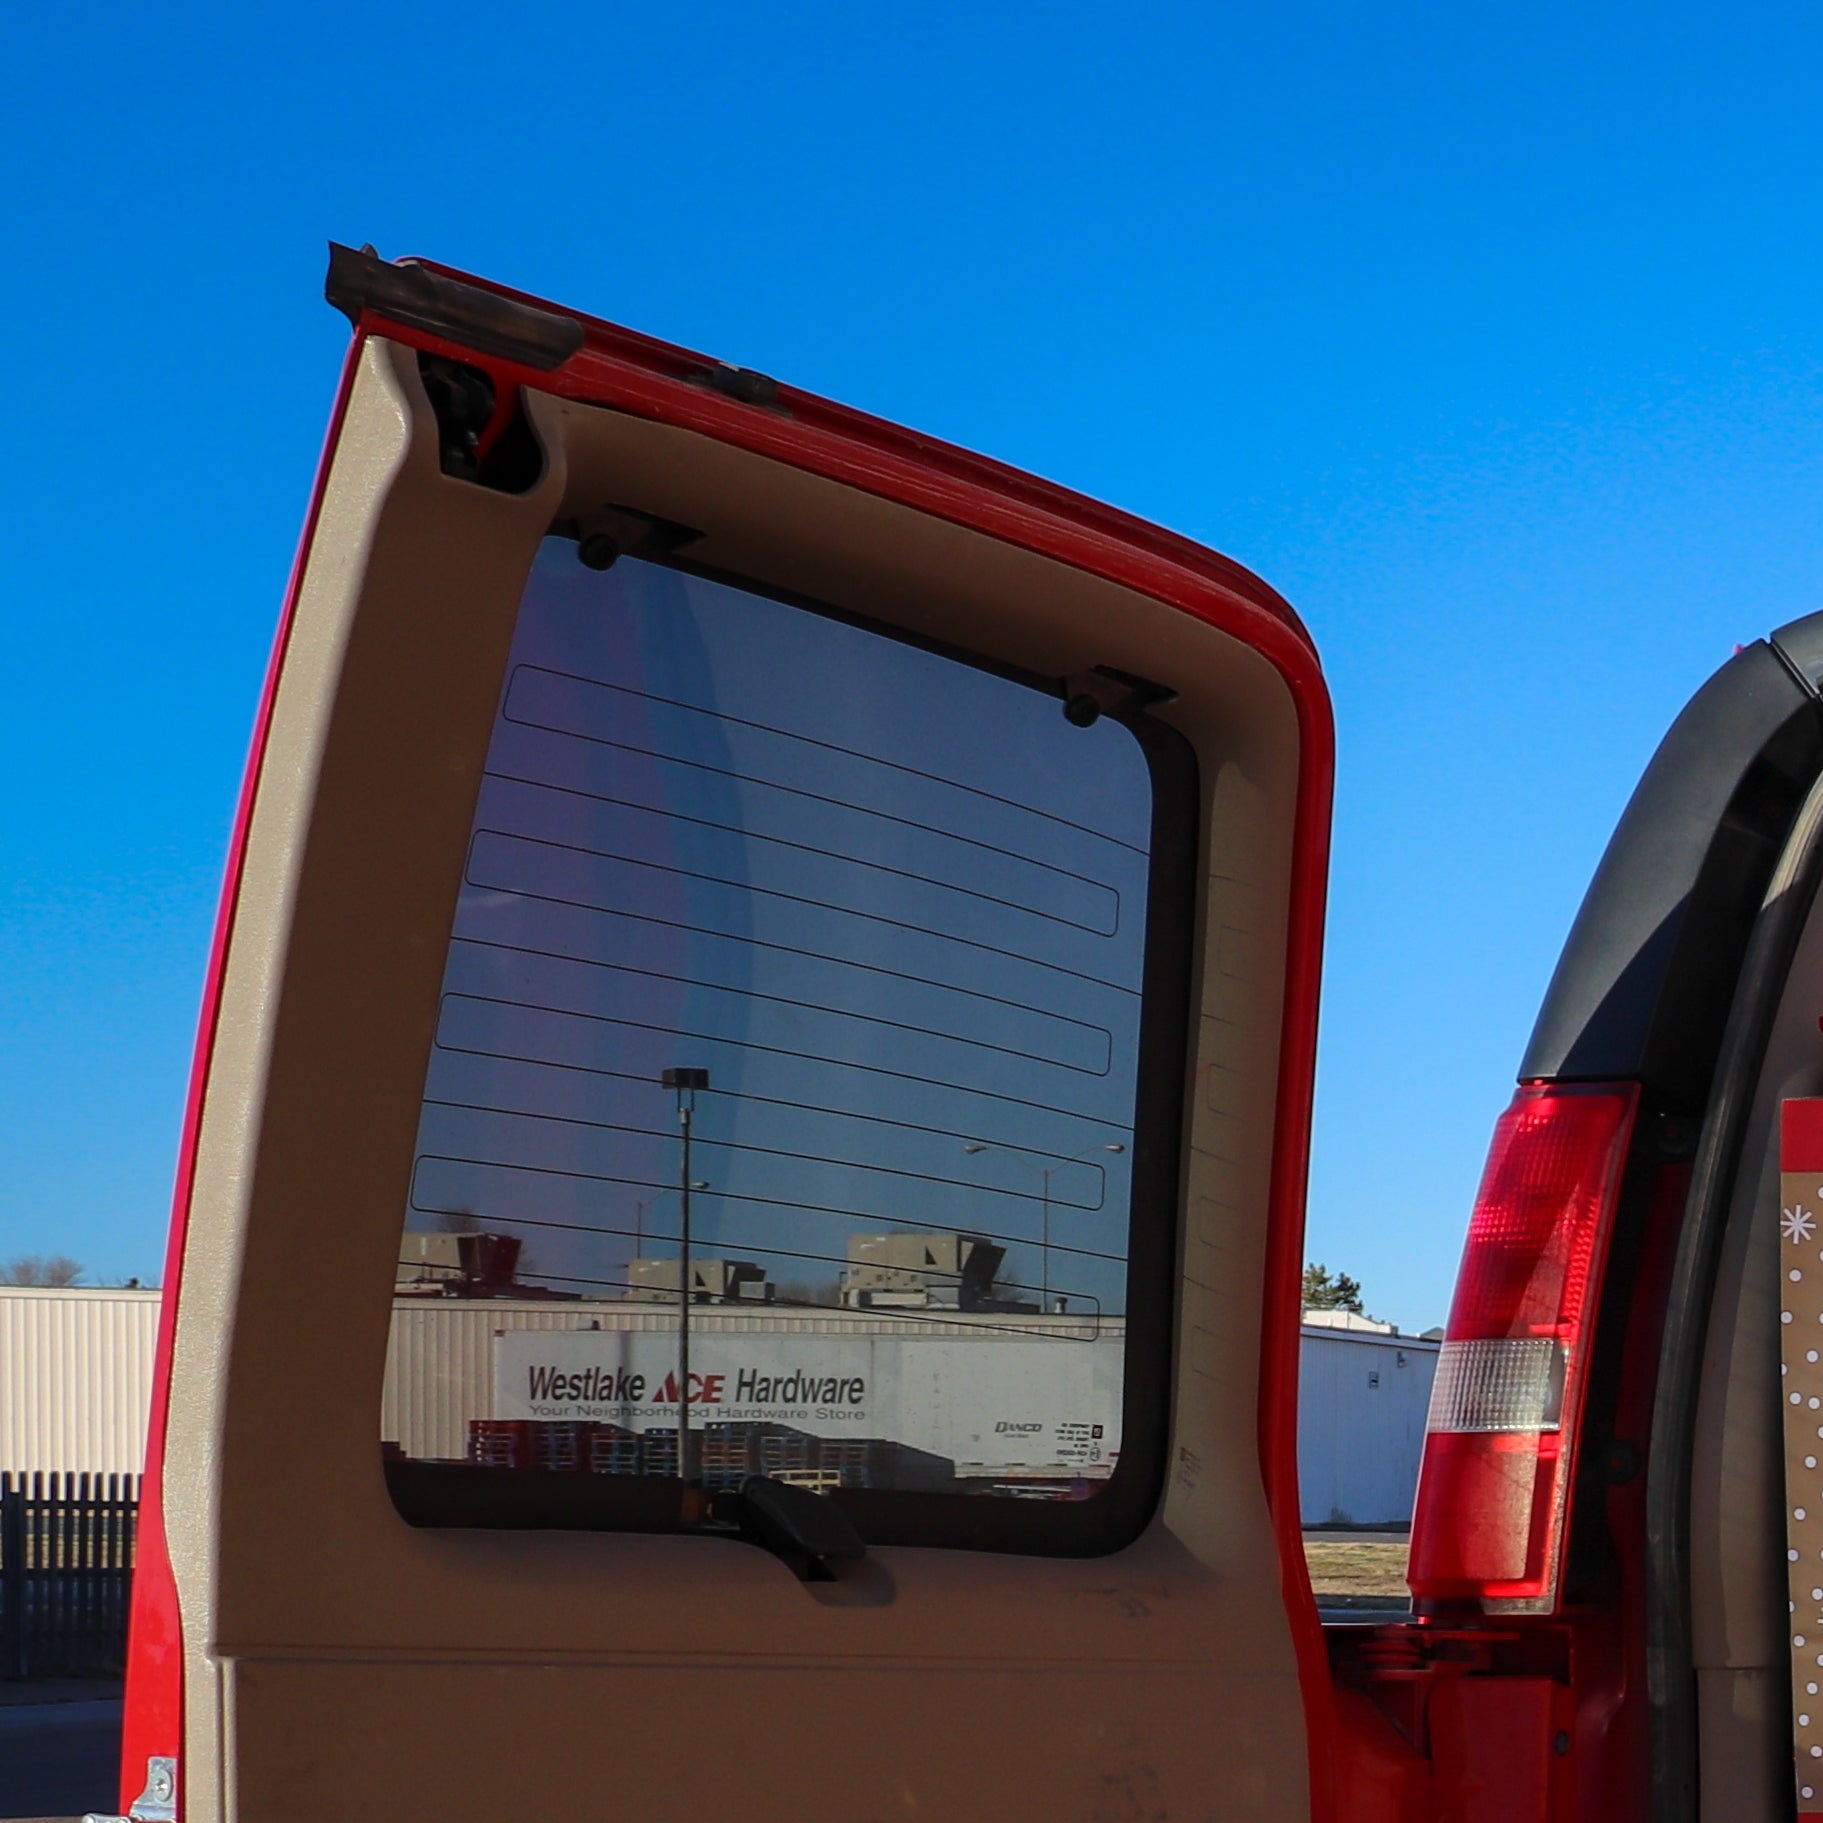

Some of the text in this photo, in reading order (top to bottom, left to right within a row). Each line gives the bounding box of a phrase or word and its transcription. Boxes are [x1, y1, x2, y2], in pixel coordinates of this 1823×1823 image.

[528, 1365, 866, 1405] Westlake ACE Hardware
[528, 1404, 570, 1417] Your
[716, 1406, 809, 1420] Hardware
[815, 1407, 866, 1421] Store
